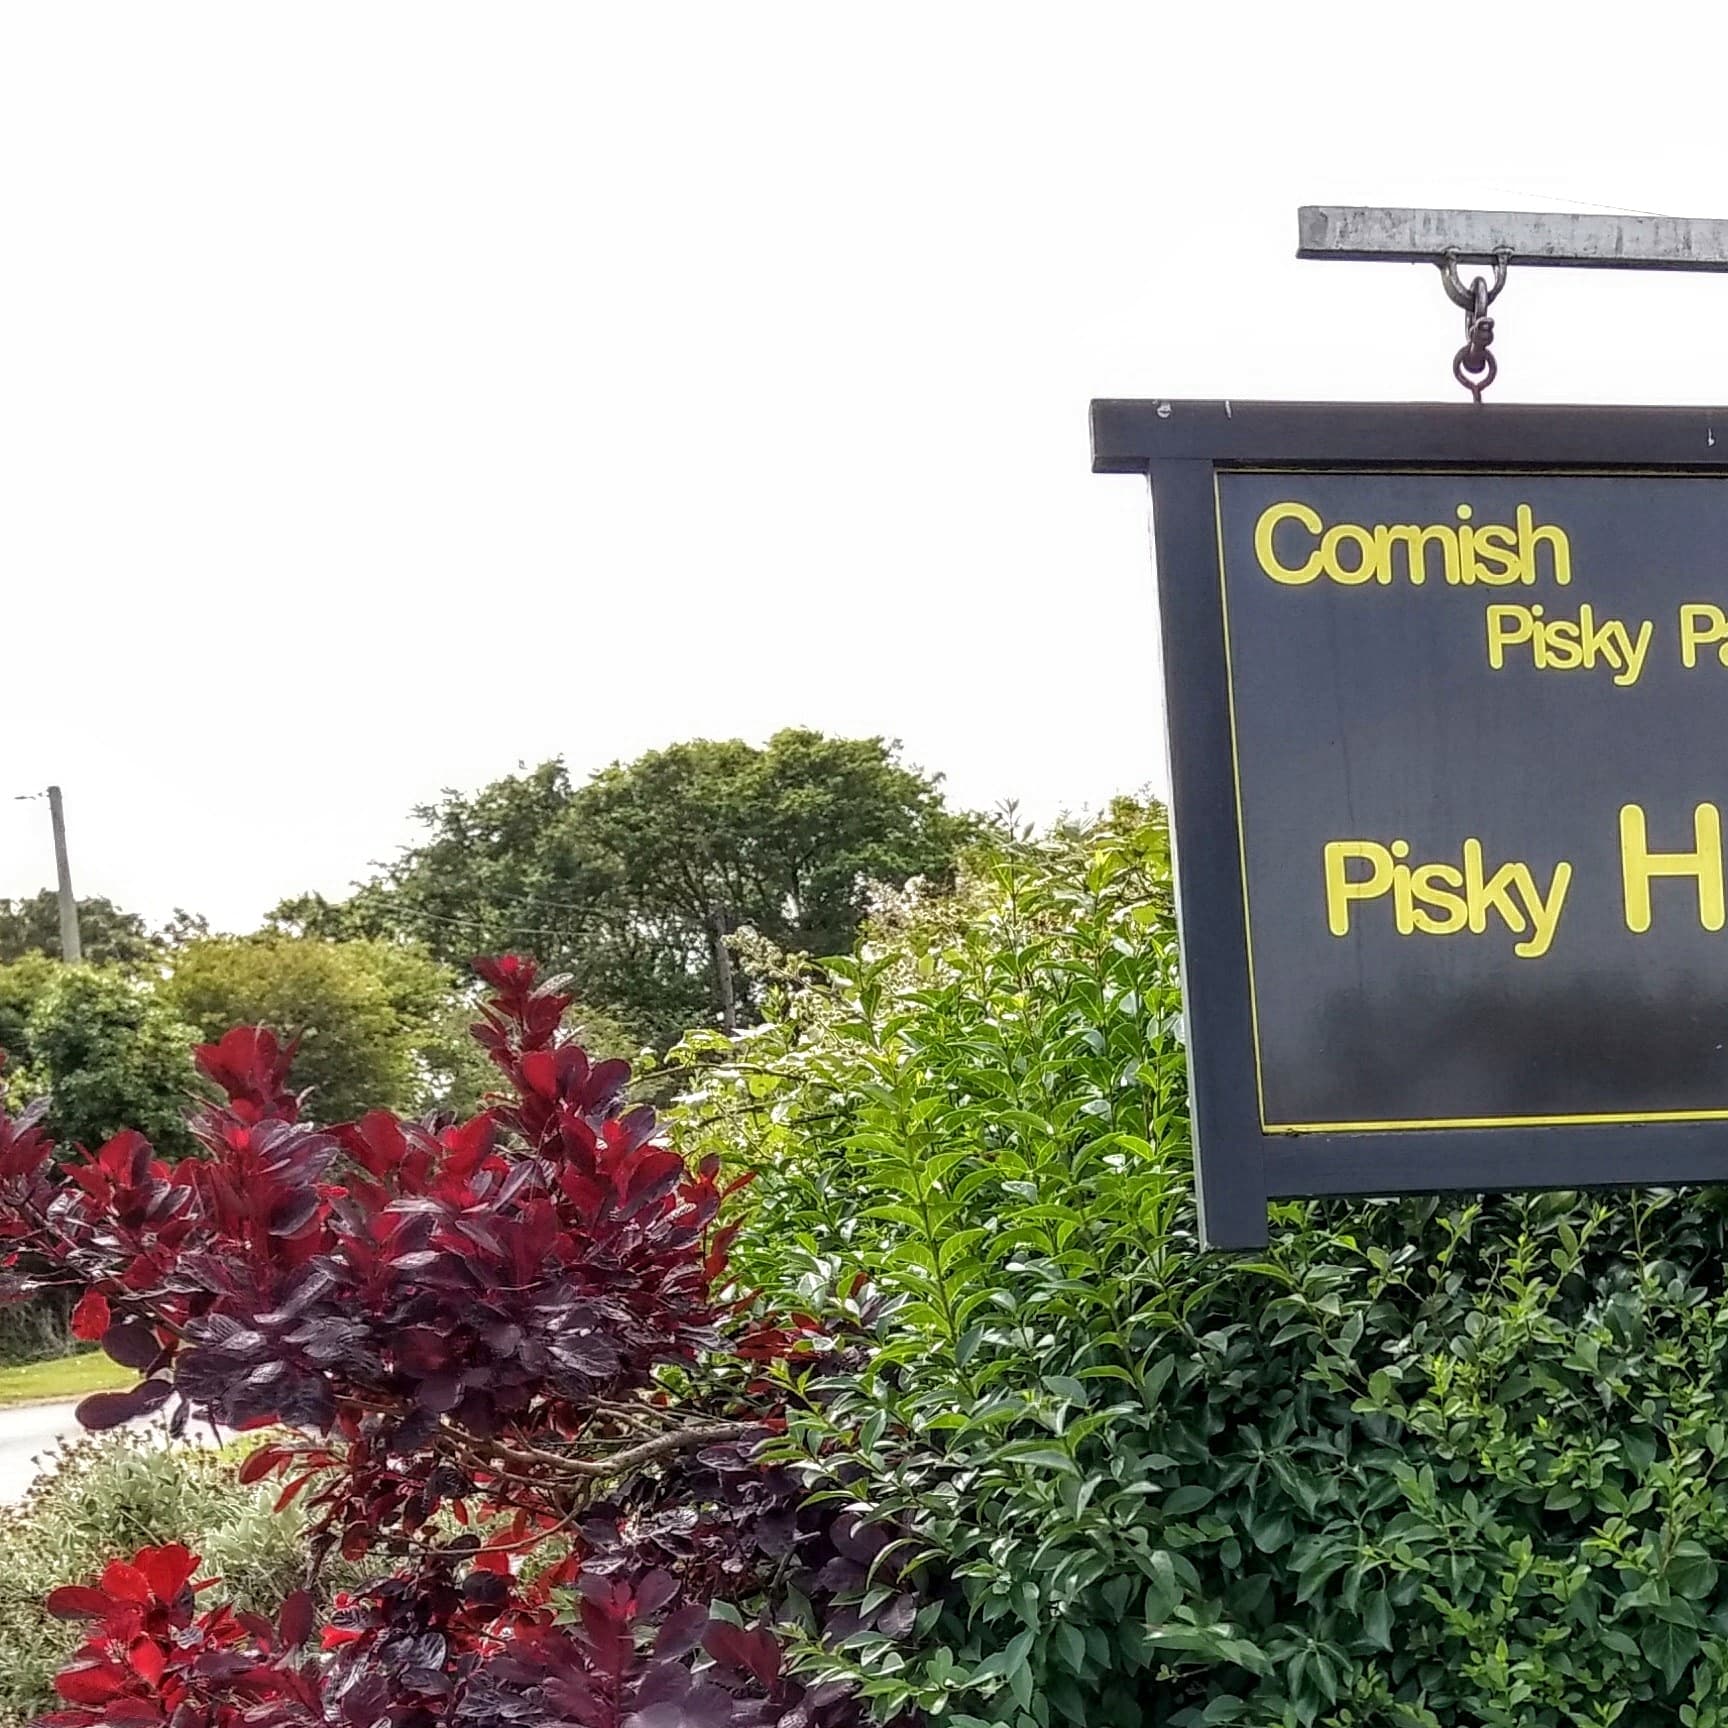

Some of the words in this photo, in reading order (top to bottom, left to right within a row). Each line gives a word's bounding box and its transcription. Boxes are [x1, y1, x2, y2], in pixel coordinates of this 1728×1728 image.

[1255, 502, 1571, 586] Cornish
[1486, 603, 1654, 687] Pisky
[1324, 838, 1572, 958] Pisky
